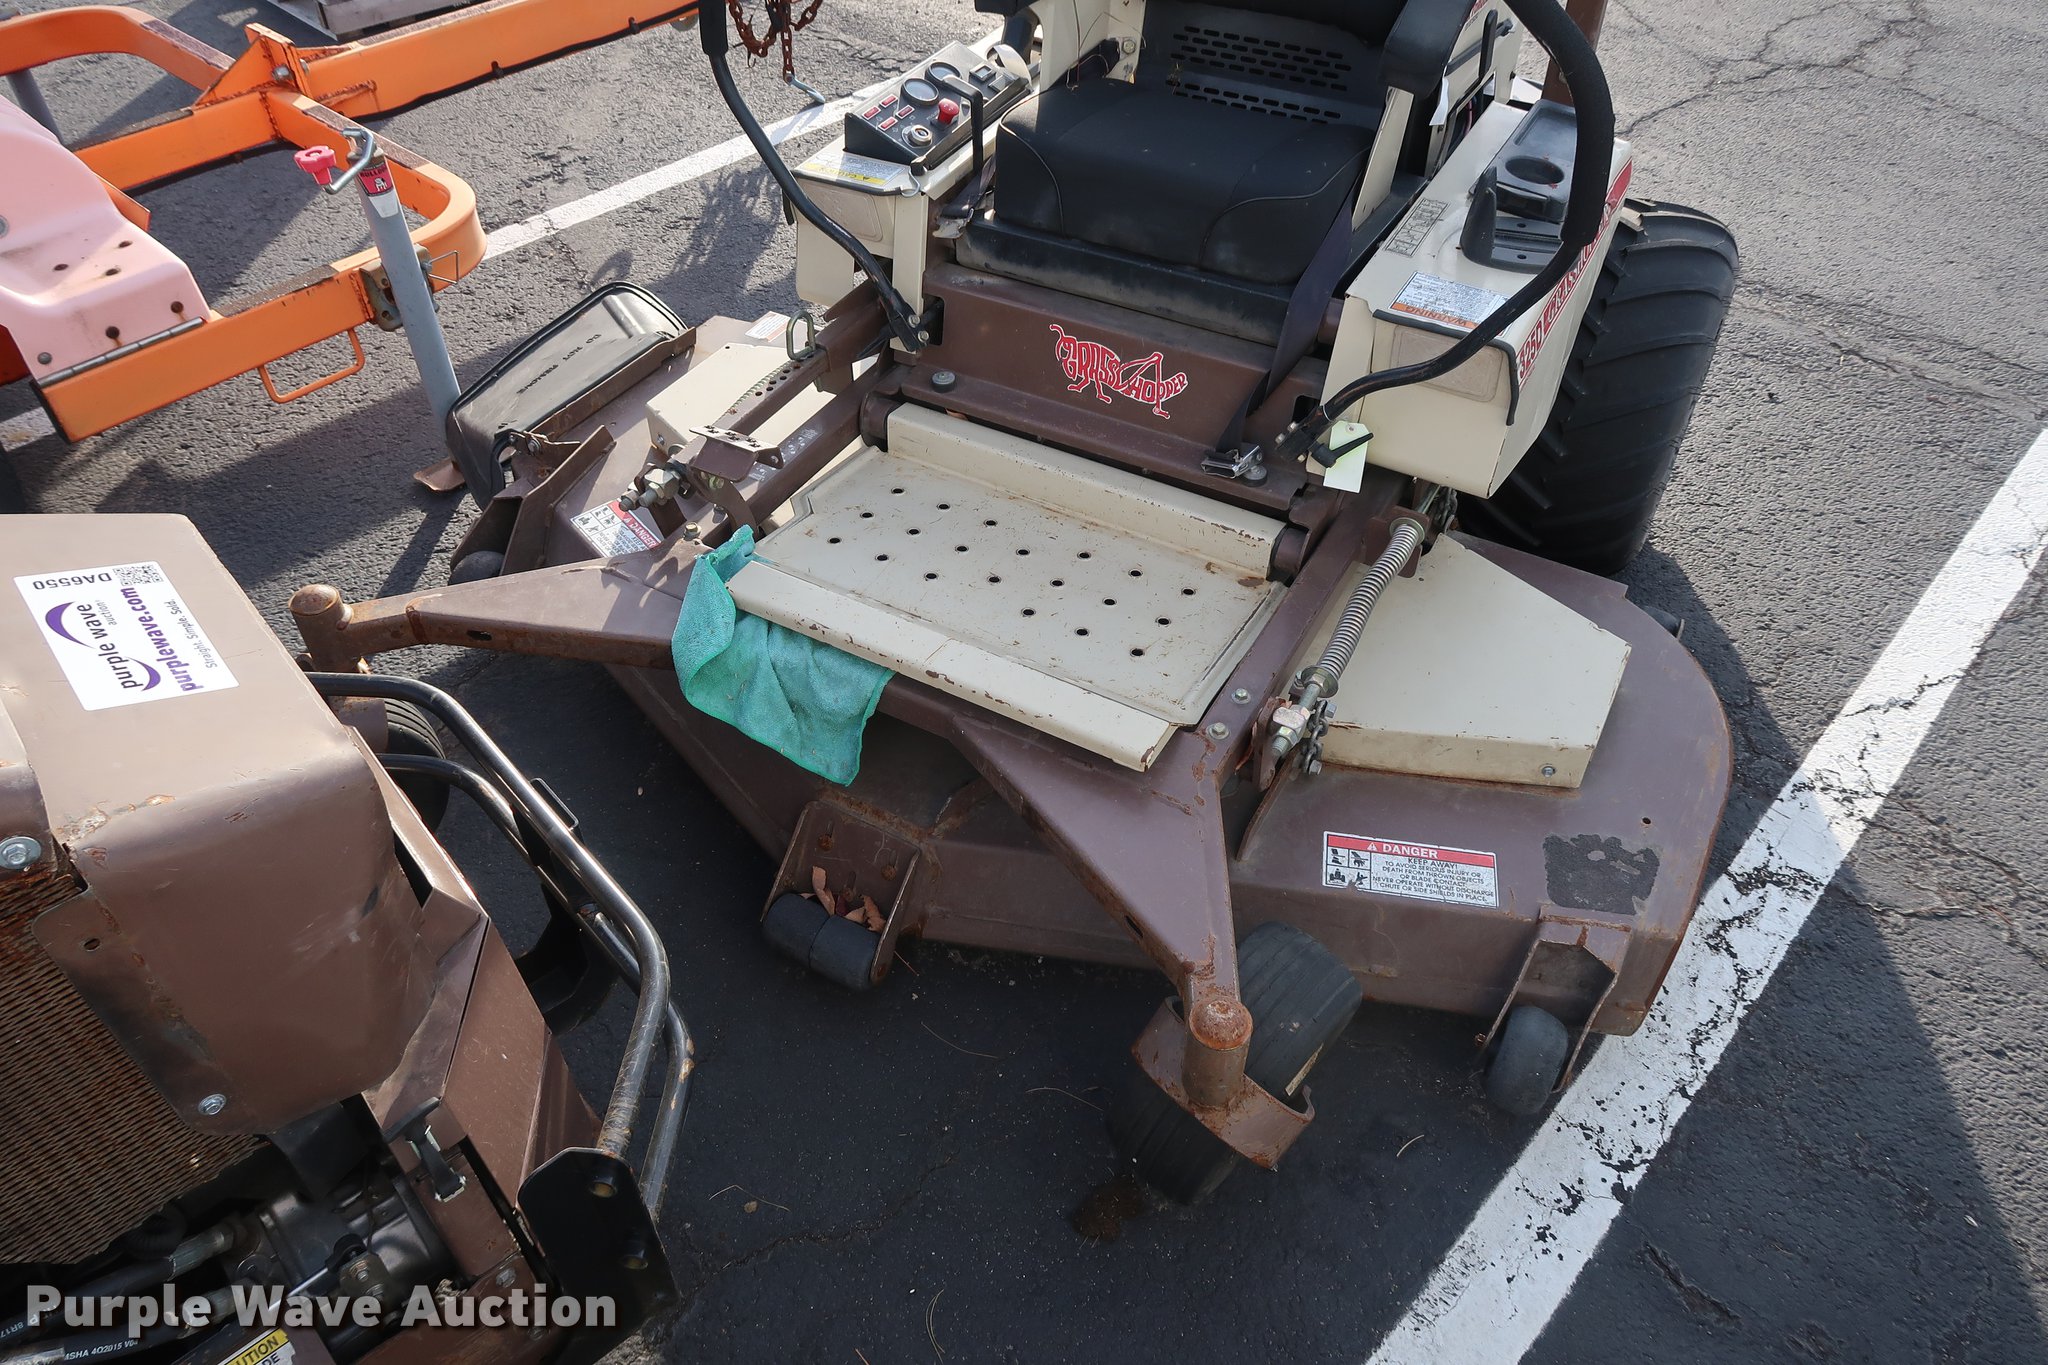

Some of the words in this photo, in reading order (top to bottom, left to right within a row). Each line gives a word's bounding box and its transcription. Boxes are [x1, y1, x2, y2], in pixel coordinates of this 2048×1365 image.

[1405, 306, 1467, 327] WARNING
[1054, 328, 1189, 409] GRASSHOPPER
[629, 522, 657, 549] DANGER
[33, 572, 112, 590] DA6550
[77, 603, 108, 640] wave
[96, 602, 117, 626] auction
[120, 587, 204, 691] purplewave.com
[98, 642, 143, 689] purple
[1383, 843, 1438, 859] DANGER
[1396, 861, 1417, 870] AVOID
[1419, 865, 1446, 874] SERIOUS
[1447, 868, 1470, 877] INJURY
[1408, 858, 1428, 866] KEEP
[1430, 861, 1458, 869] AWAY!
[1382, 866, 1403, 874] DEATH
[1405, 868, 1425, 876] FROM
[1426, 871, 1455, 880] THROWN
[1456, 876, 1485, 885] OBJECTS
[1411, 875, 1431, 883] BLADE
[1380, 882, 1400, 890] CHUTE
[1413, 886, 1428, 894] SIDE
[1430, 889, 1456, 898] SHIELDS
[1397, 878, 1424, 888] OPERATE
[1425, 882, 1454, 892] WITHOUT
[1456, 887, 1494, 898] DISCHARGE
[236, 1335, 279, 1365] UTION
